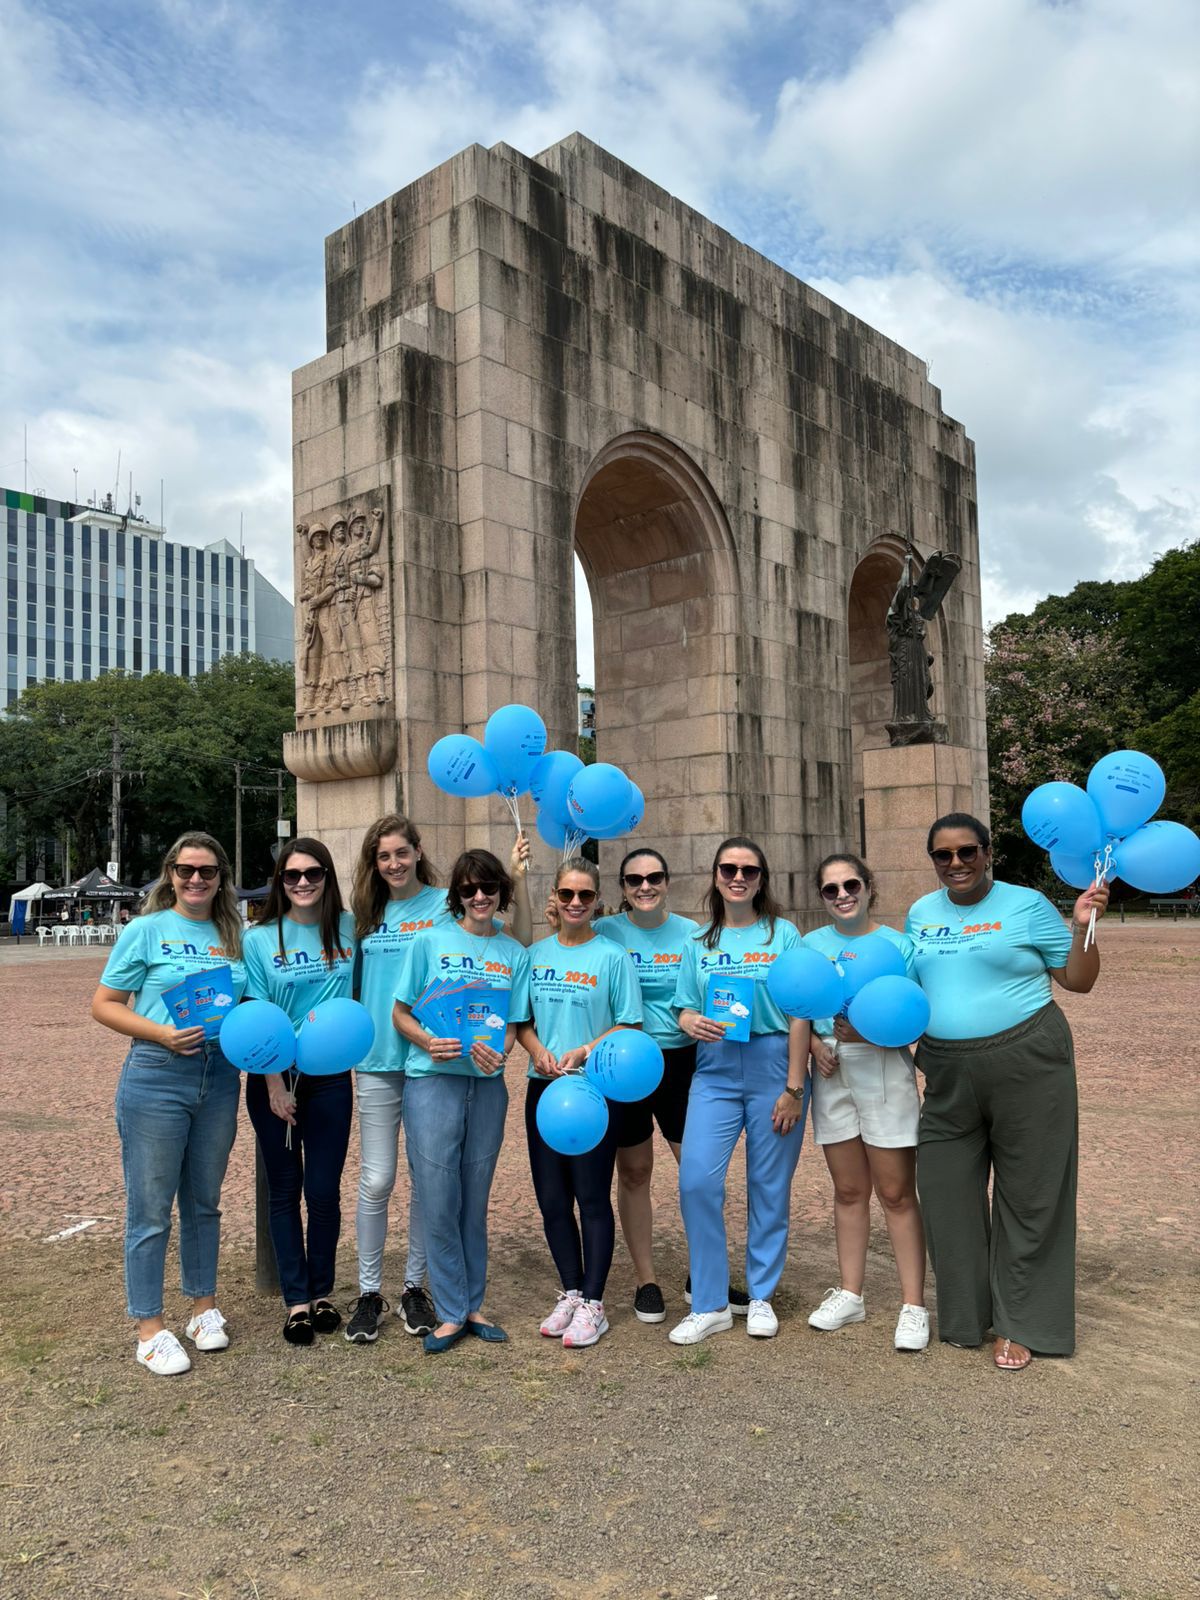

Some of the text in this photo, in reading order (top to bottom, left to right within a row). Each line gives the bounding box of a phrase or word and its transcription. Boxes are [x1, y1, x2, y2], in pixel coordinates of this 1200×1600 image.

[399, 919, 433, 933] 2024
[962, 921, 1002, 935] 2024
[563, 970, 597, 988] 2024
